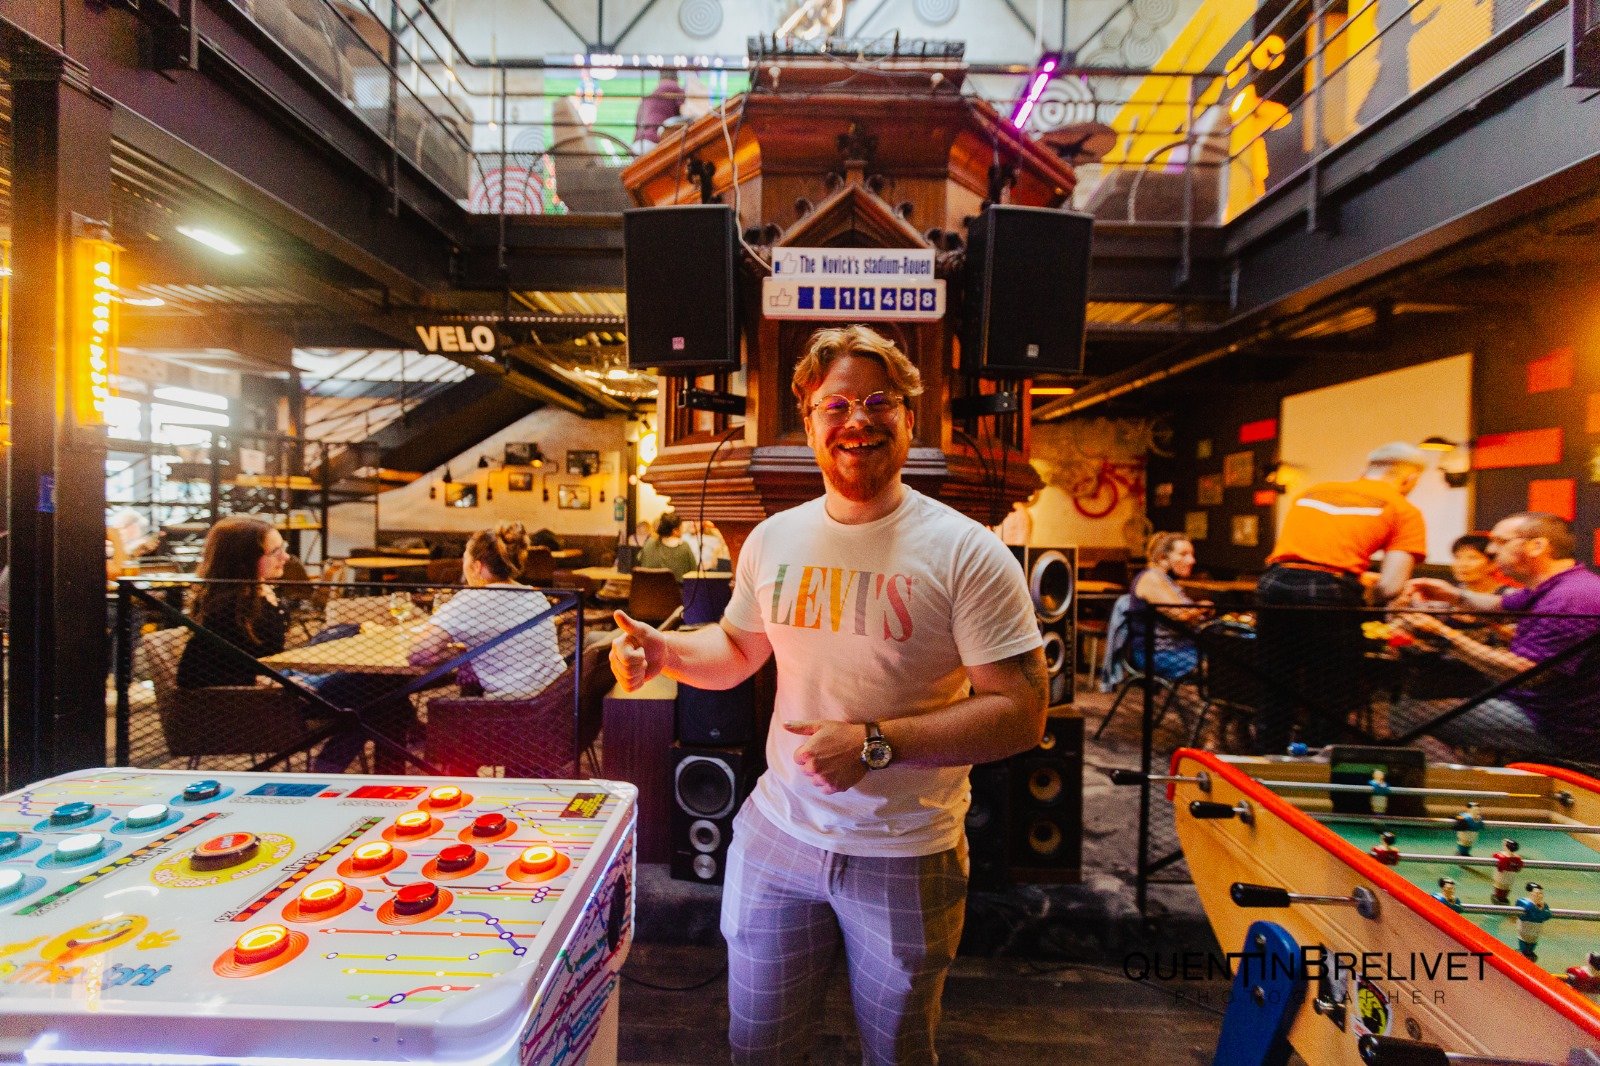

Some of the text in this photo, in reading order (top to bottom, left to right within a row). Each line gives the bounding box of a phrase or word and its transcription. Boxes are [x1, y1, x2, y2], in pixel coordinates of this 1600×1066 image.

[799, 254, 931, 275] The Novick's stadium-Rouen
[842, 290, 934, 308] 11488
[415, 325, 496, 352] VELO
[770, 563, 914, 642] LEVI'S
